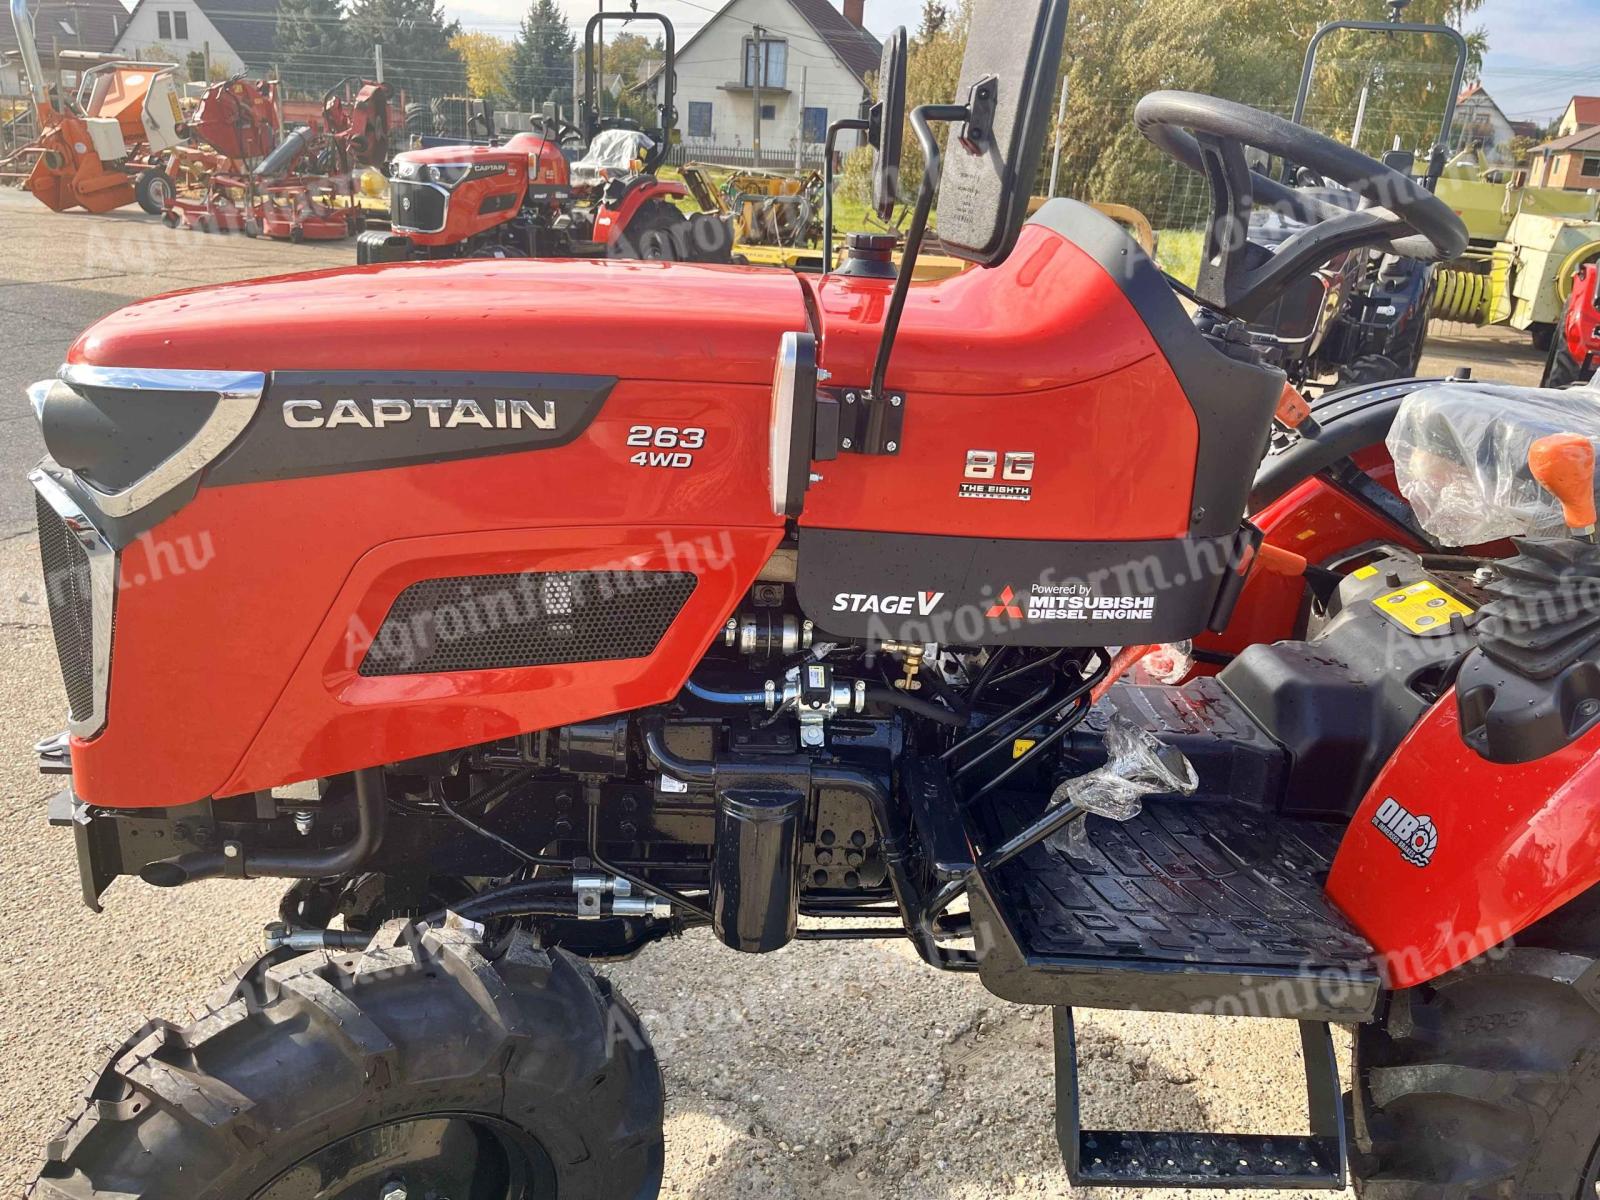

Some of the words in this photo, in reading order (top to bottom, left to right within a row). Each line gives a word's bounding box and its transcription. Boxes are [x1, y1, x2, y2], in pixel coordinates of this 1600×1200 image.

[282, 399, 557, 430] CAPTAIN
[626, 425, 706, 449] 263
[630, 451, 693, 468] 4WD
[964, 450, 1035, 481] 8G
[961, 484, 984, 492] THE
[988, 486, 1029, 494] EIGHTH
[1031, 583, 1076, 595] Powered
[1079, 584, 1092, 597] by
[832, 593, 915, 615] STAGE
[917, 591, 945, 616] V
[1029, 596, 1155, 609] MITSUBISHI
[1027, 609, 1088, 619] DIESEL
[1091, 609, 1152, 620] ENGINE
